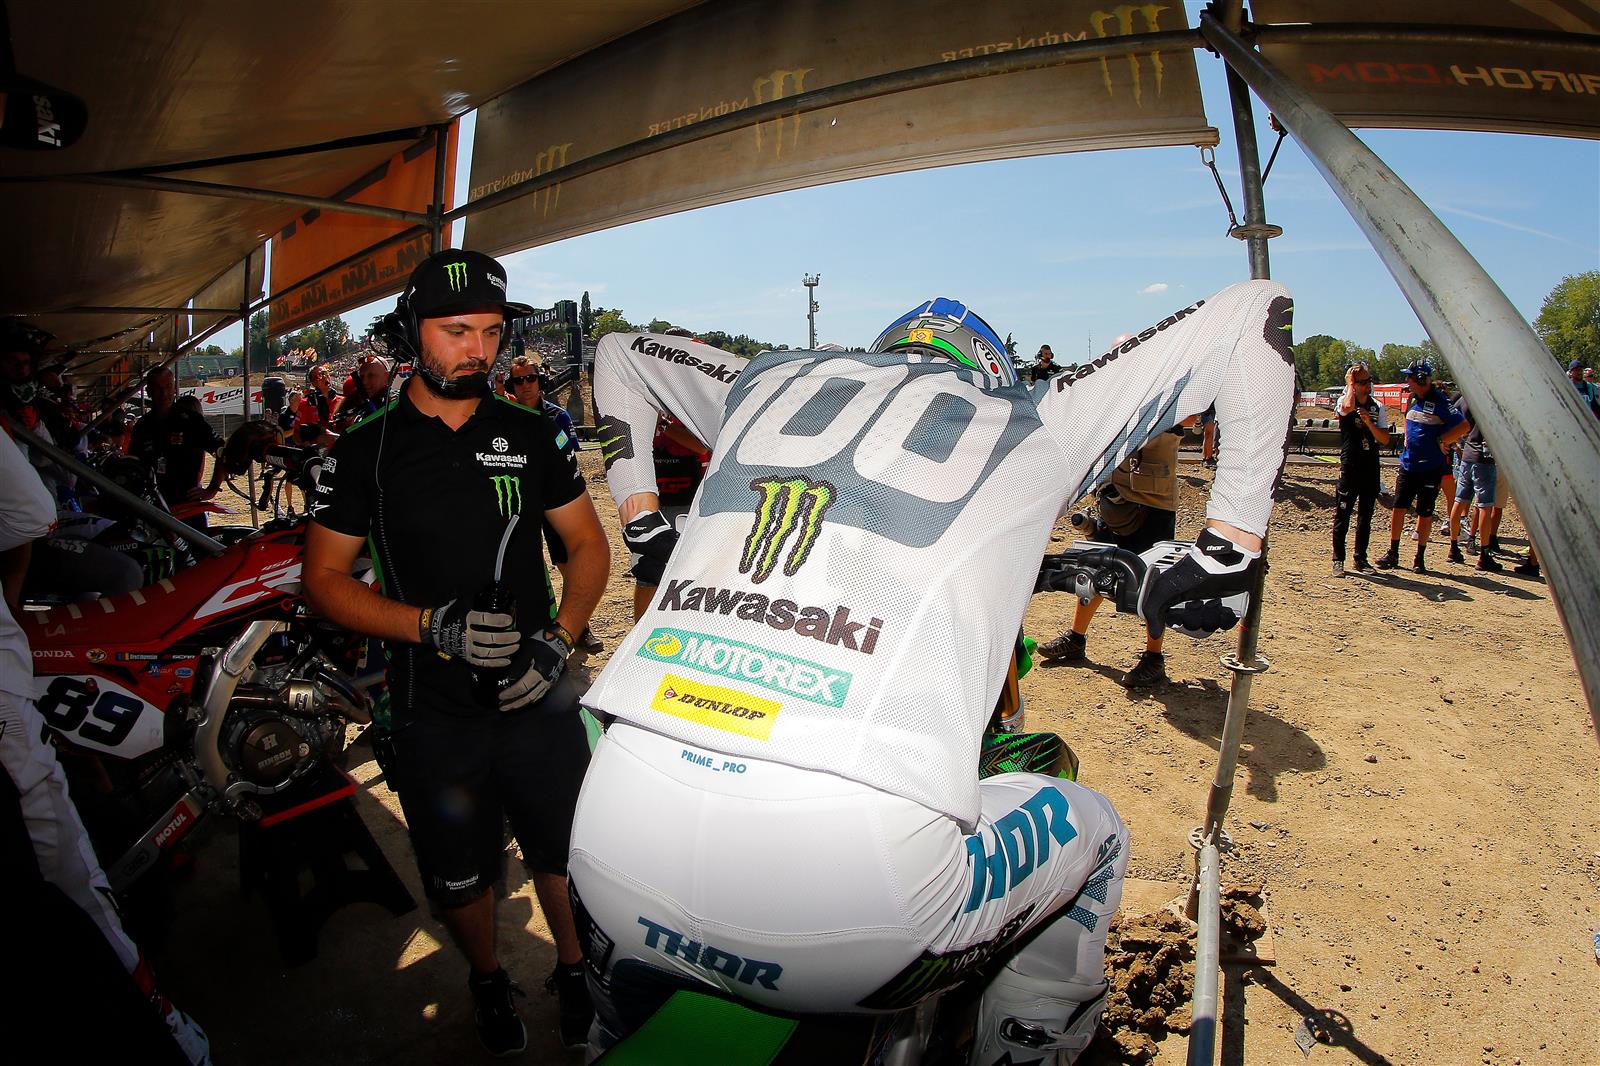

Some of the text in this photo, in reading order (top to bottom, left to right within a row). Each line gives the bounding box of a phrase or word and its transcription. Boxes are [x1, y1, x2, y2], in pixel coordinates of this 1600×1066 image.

[525, 310, 558, 327] FINISH
[630, 336, 742, 385] Kawasaki
[706, 356, 1012, 505] 100
[475, 452, 528, 465] Kawasaki
[483, 461, 524, 470] Racing Team
[657, 579, 886, 656] Kawasaki
[30, 650, 76, 659] ONDA
[679, 636, 843, 703] MOTOREX
[37, 676, 145, 748] 89
[677, 692, 767, 721] DUNLOP
[154, 812, 188, 847] MOTUL
[637, 915, 785, 992] THOR
